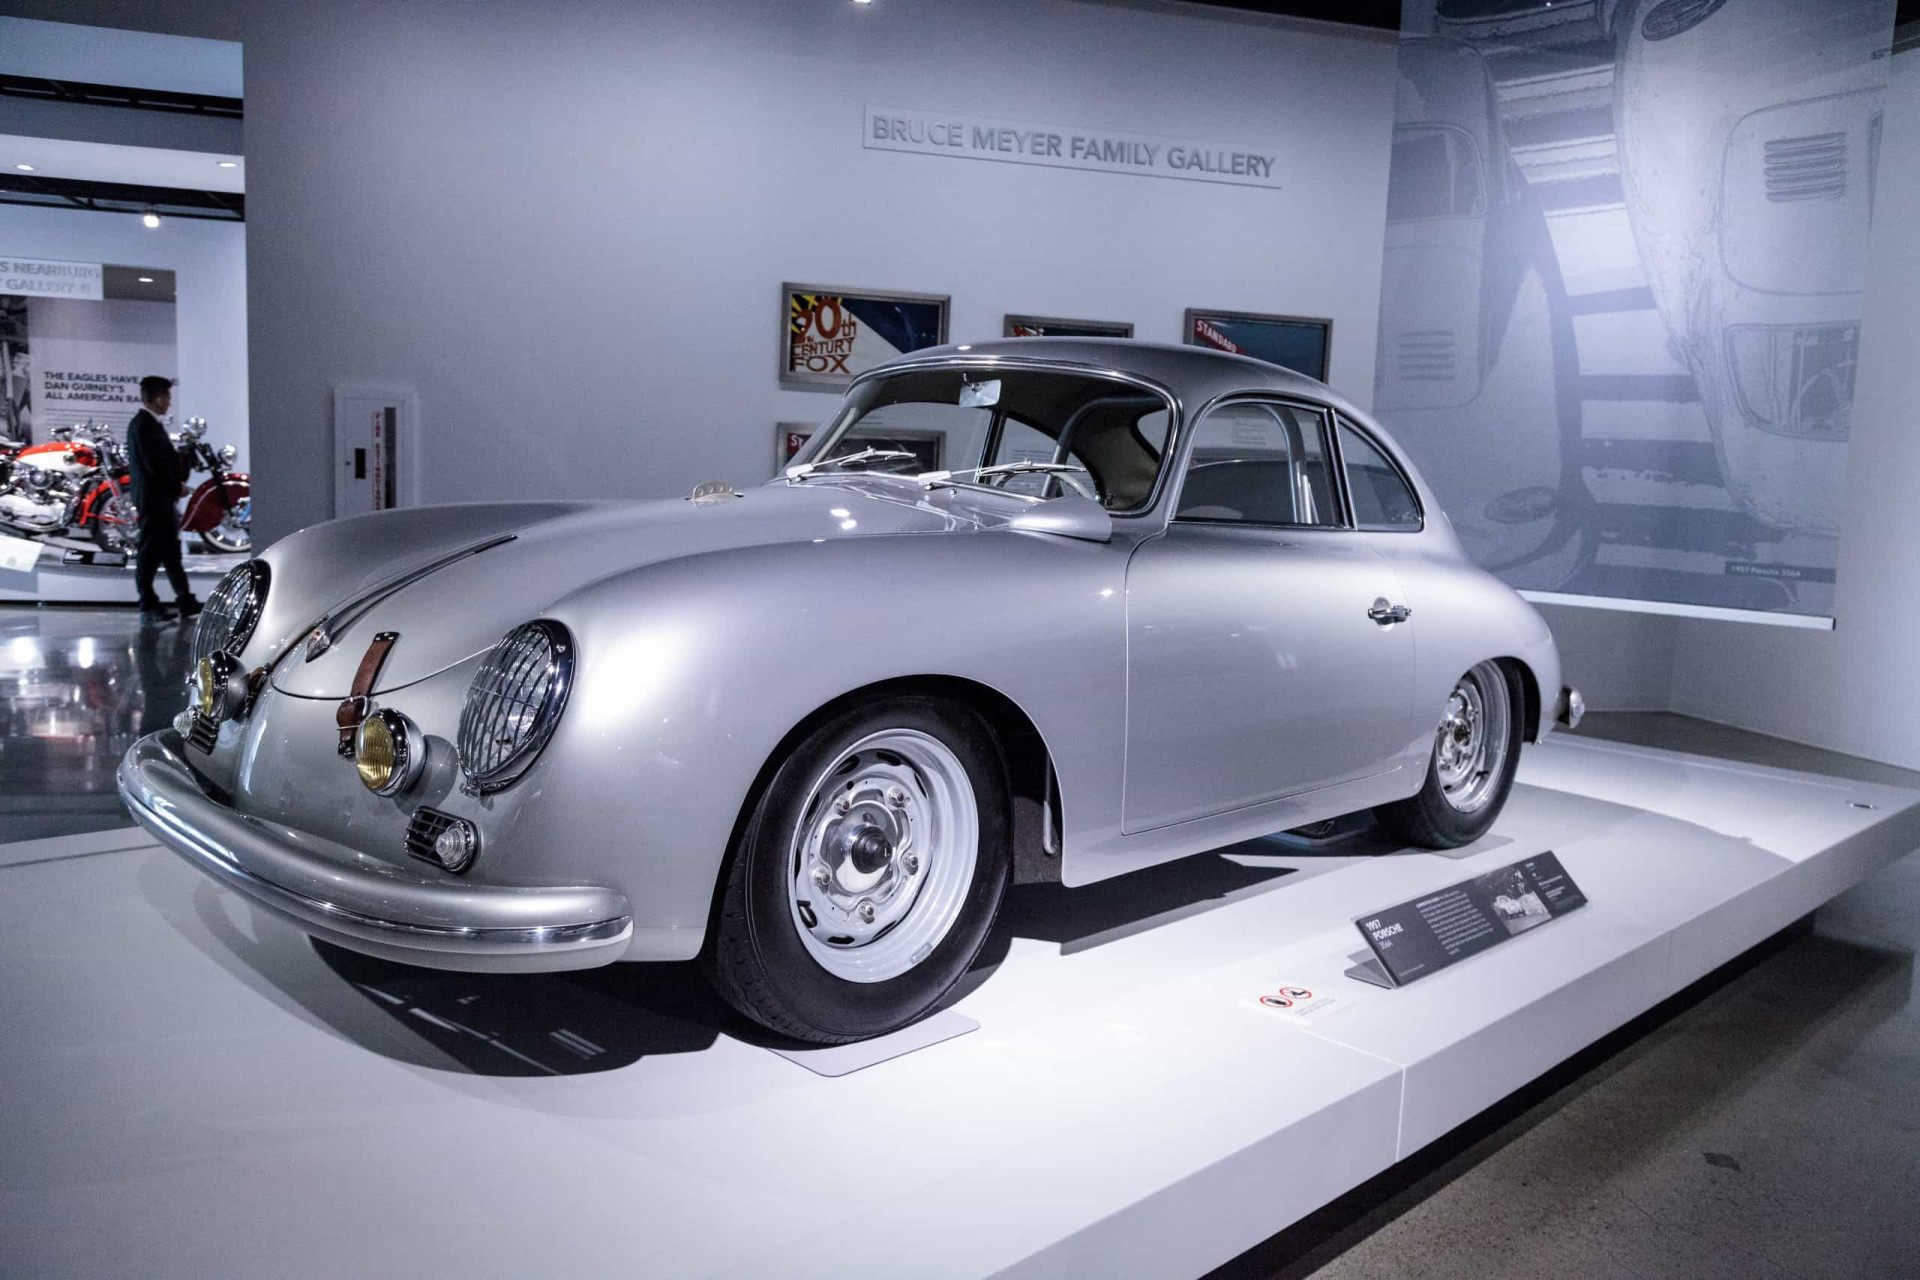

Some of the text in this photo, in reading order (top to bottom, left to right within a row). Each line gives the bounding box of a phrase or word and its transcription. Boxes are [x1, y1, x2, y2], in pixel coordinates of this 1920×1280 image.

[872, 114, 1277, 179] BRUCE MEYER FAMILY GALLERY
[6, 278, 75, 293] GALLERY
[791, 296, 857, 344] 20th
[792, 337, 855, 356] CENTURY
[1196, 320, 1237, 354] STANDARD
[792, 354, 851, 374] FOX
[43, 371, 139, 384] THE EAGLES HAVE
[44, 381, 125, 393] DAN GURNEY'S
[44, 391, 65, 400] ALL
[66, 392, 124, 402] AMERICAN
[1366, 919, 1381, 931] 1957
[1372, 922, 1404, 941] PORSCHE
